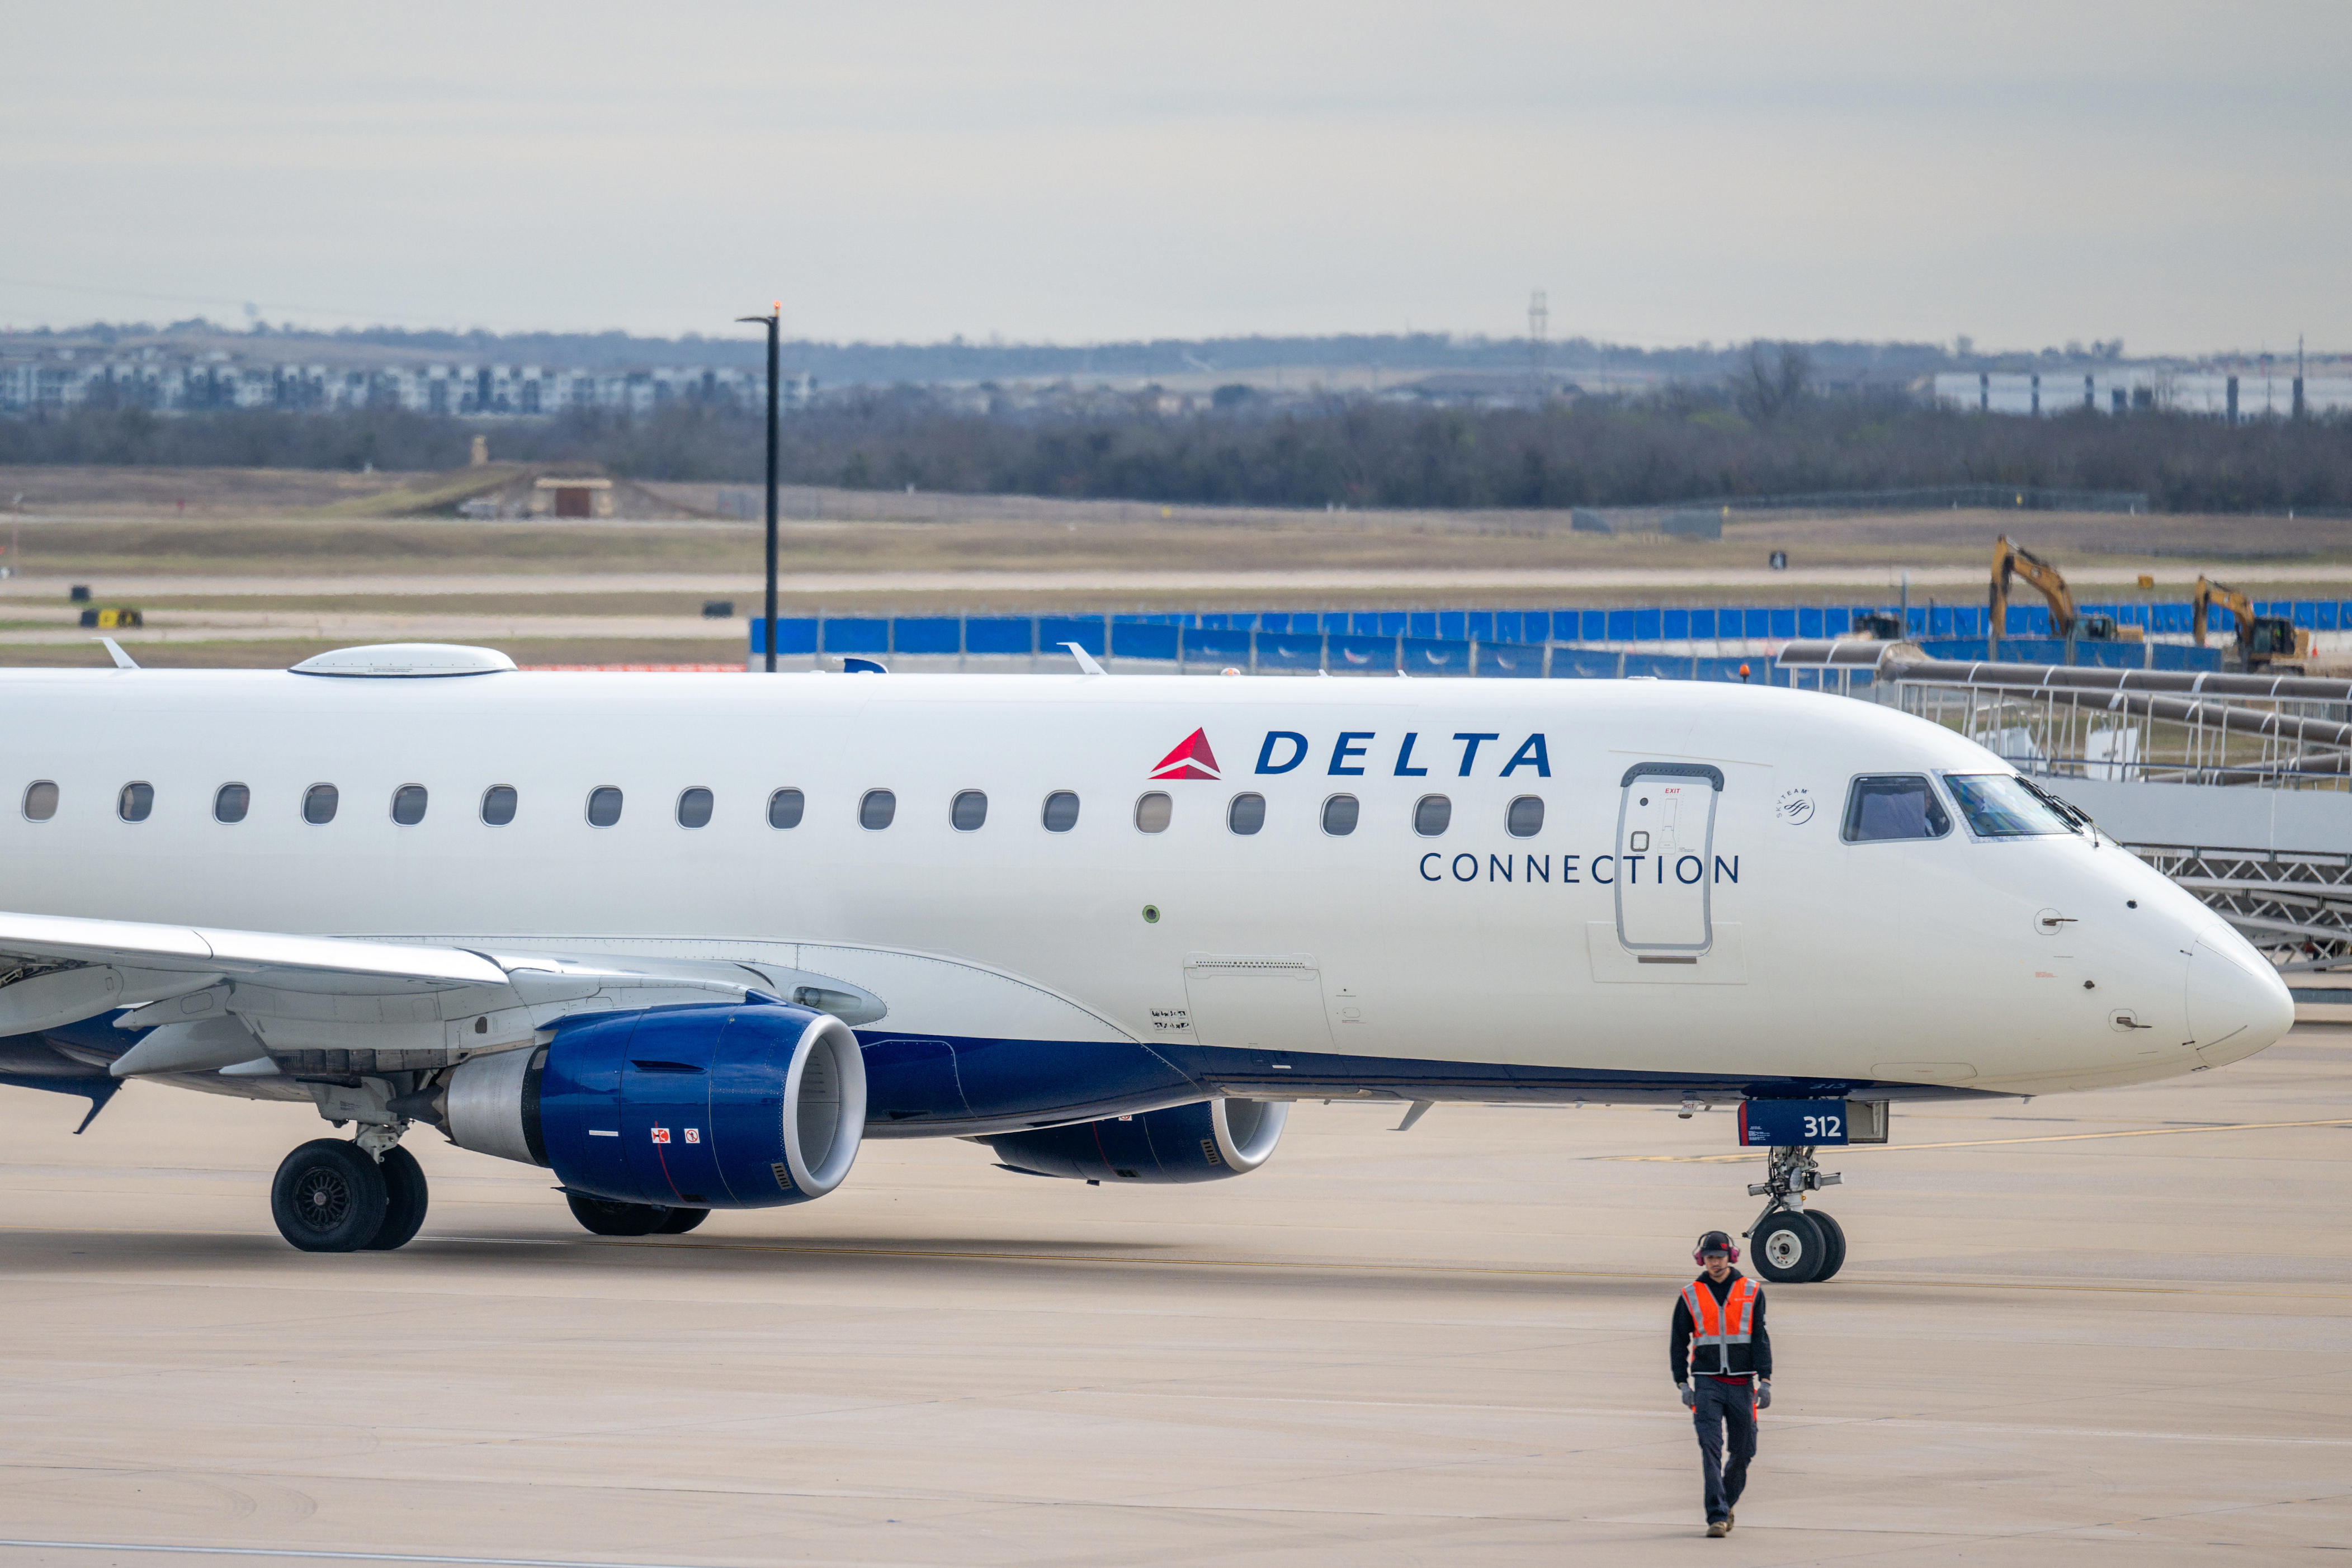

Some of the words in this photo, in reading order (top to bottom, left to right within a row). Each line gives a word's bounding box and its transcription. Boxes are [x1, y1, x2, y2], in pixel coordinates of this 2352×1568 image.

[1254, 731, 1551, 777] DELTA
[1776, 788, 1807, 818] SKYTEAM
[1420, 853, 1738, 884] CONNECTION
[1803, 1116, 1841, 1137] 312
